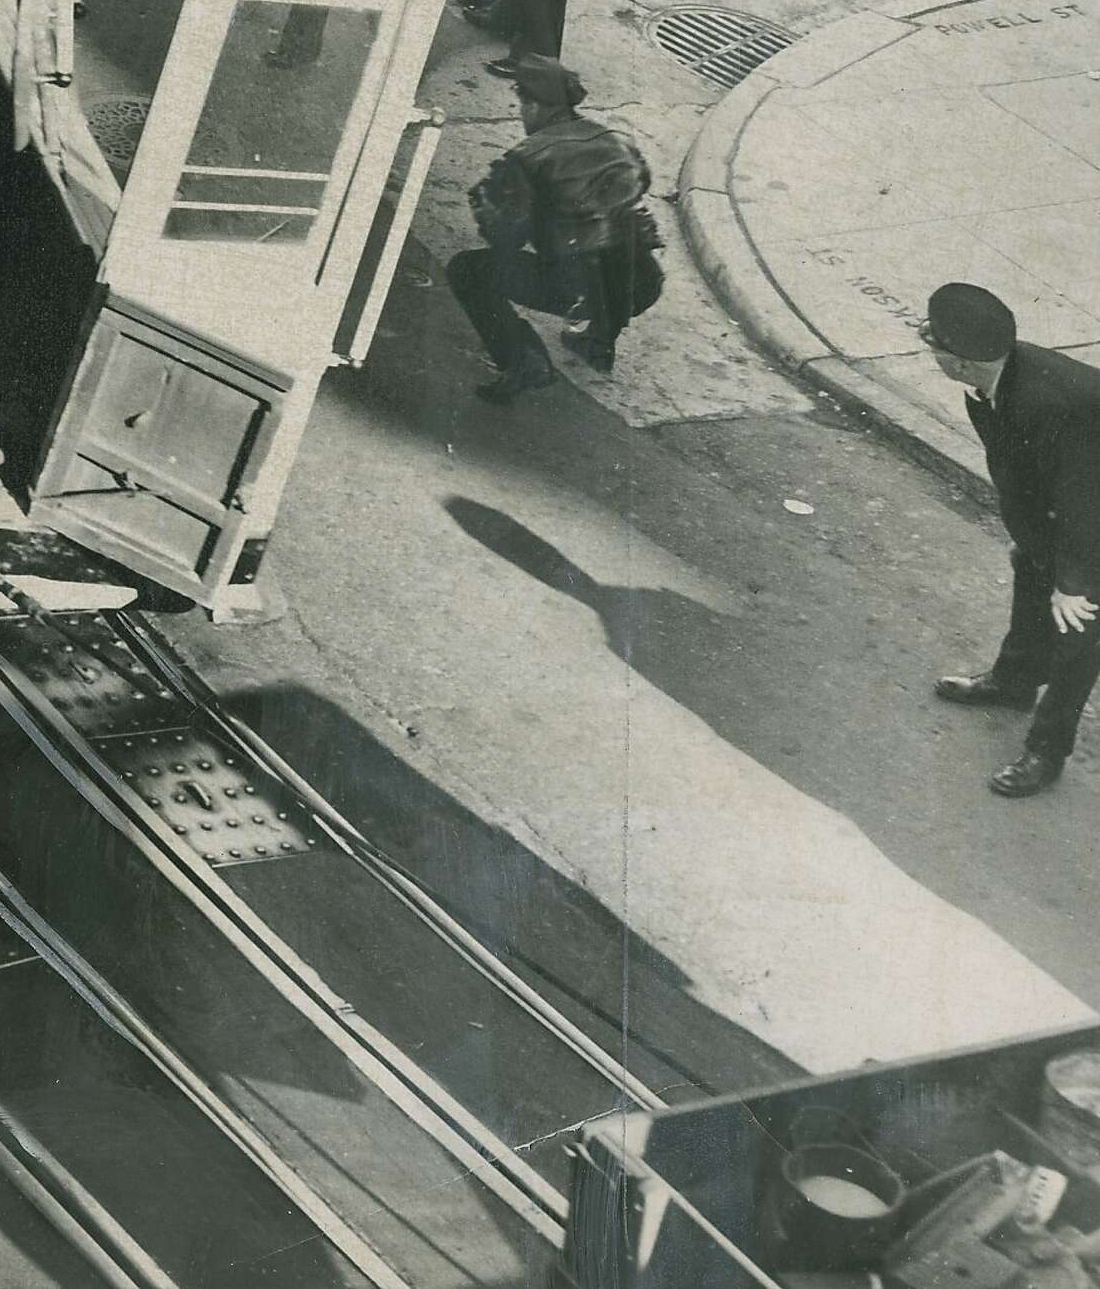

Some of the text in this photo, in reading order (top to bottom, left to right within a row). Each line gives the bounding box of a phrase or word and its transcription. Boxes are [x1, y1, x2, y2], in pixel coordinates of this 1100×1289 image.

[934, 4, 1085, 36] POWELL ST
[806, 248, 845, 265] ST
